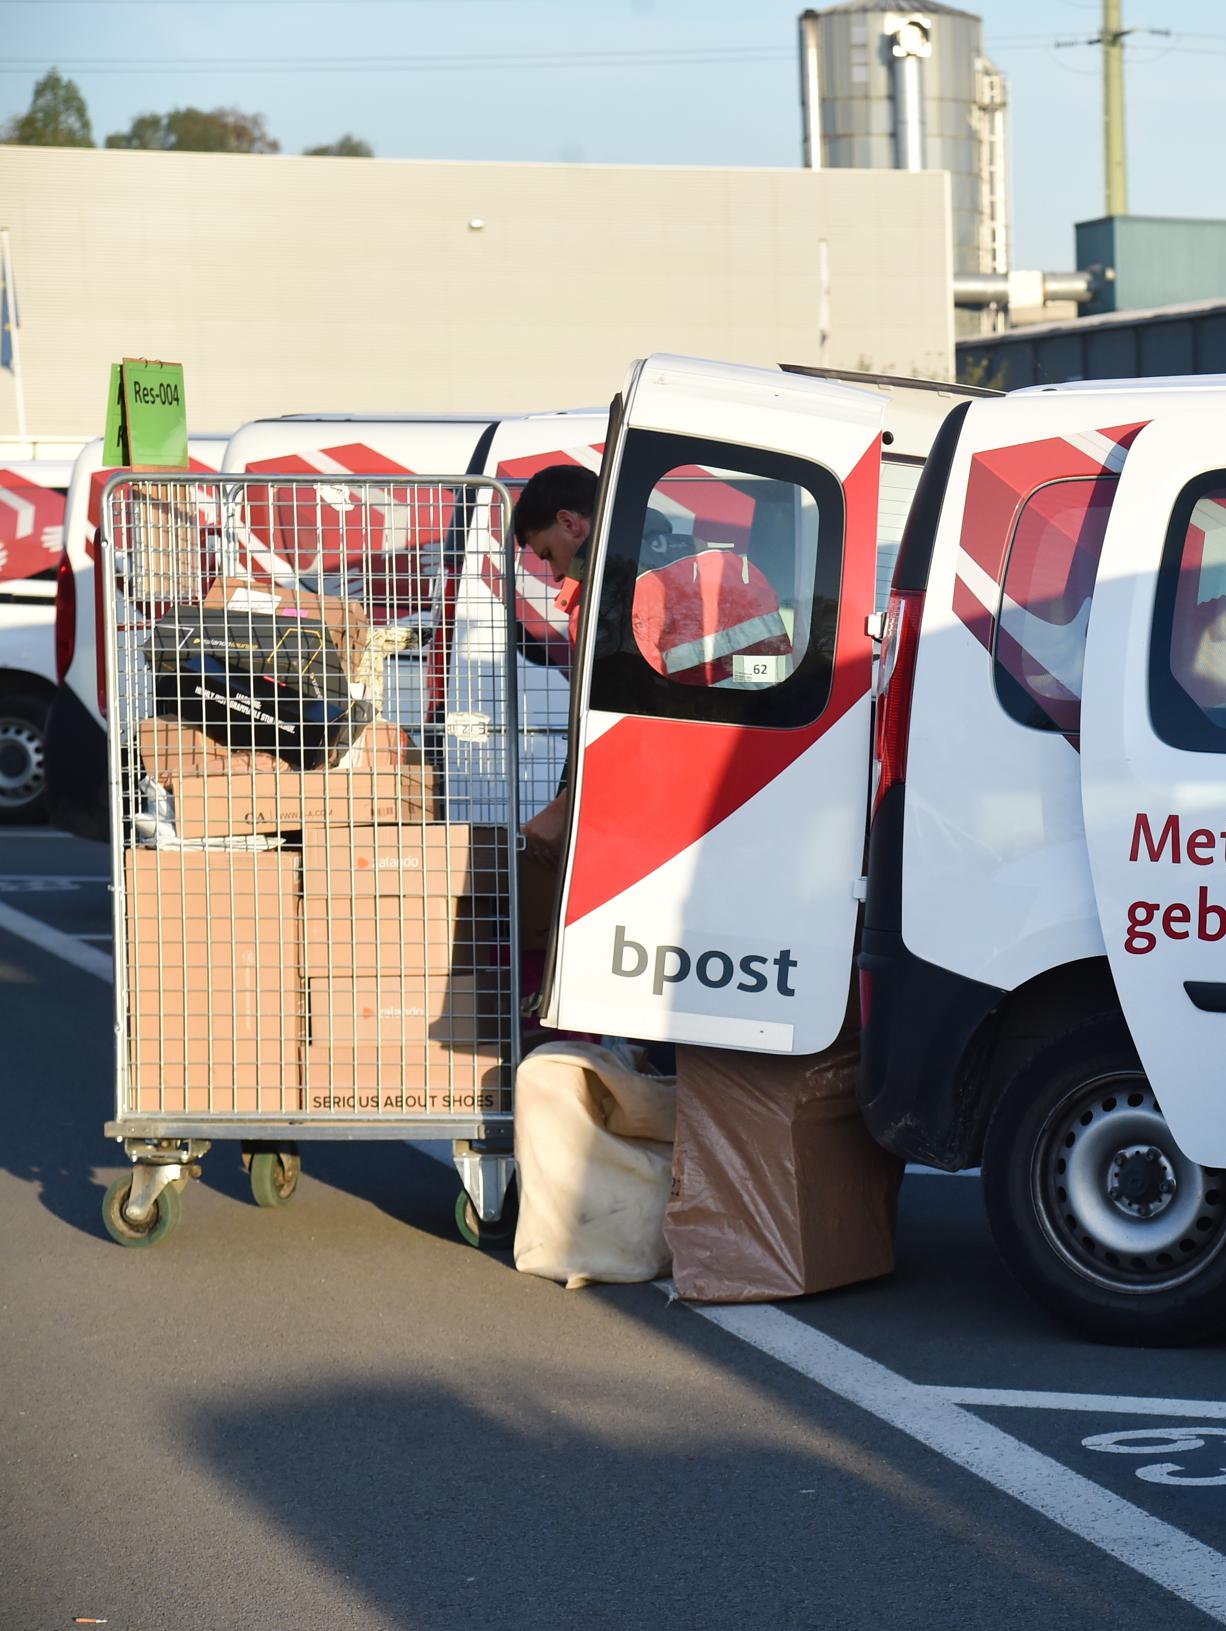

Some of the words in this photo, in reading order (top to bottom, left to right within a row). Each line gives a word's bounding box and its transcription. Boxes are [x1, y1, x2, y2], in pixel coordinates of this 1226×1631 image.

[133, 381, 179, 406] Res-004
[753, 664, 767, 675] 62
[611, 925, 798, 997] bpost
[313, 1096, 379, 1109] SERIOUS
[383, 1095, 438, 1108] ABOUT
[442, 1094, 494, 1108] SHOES
